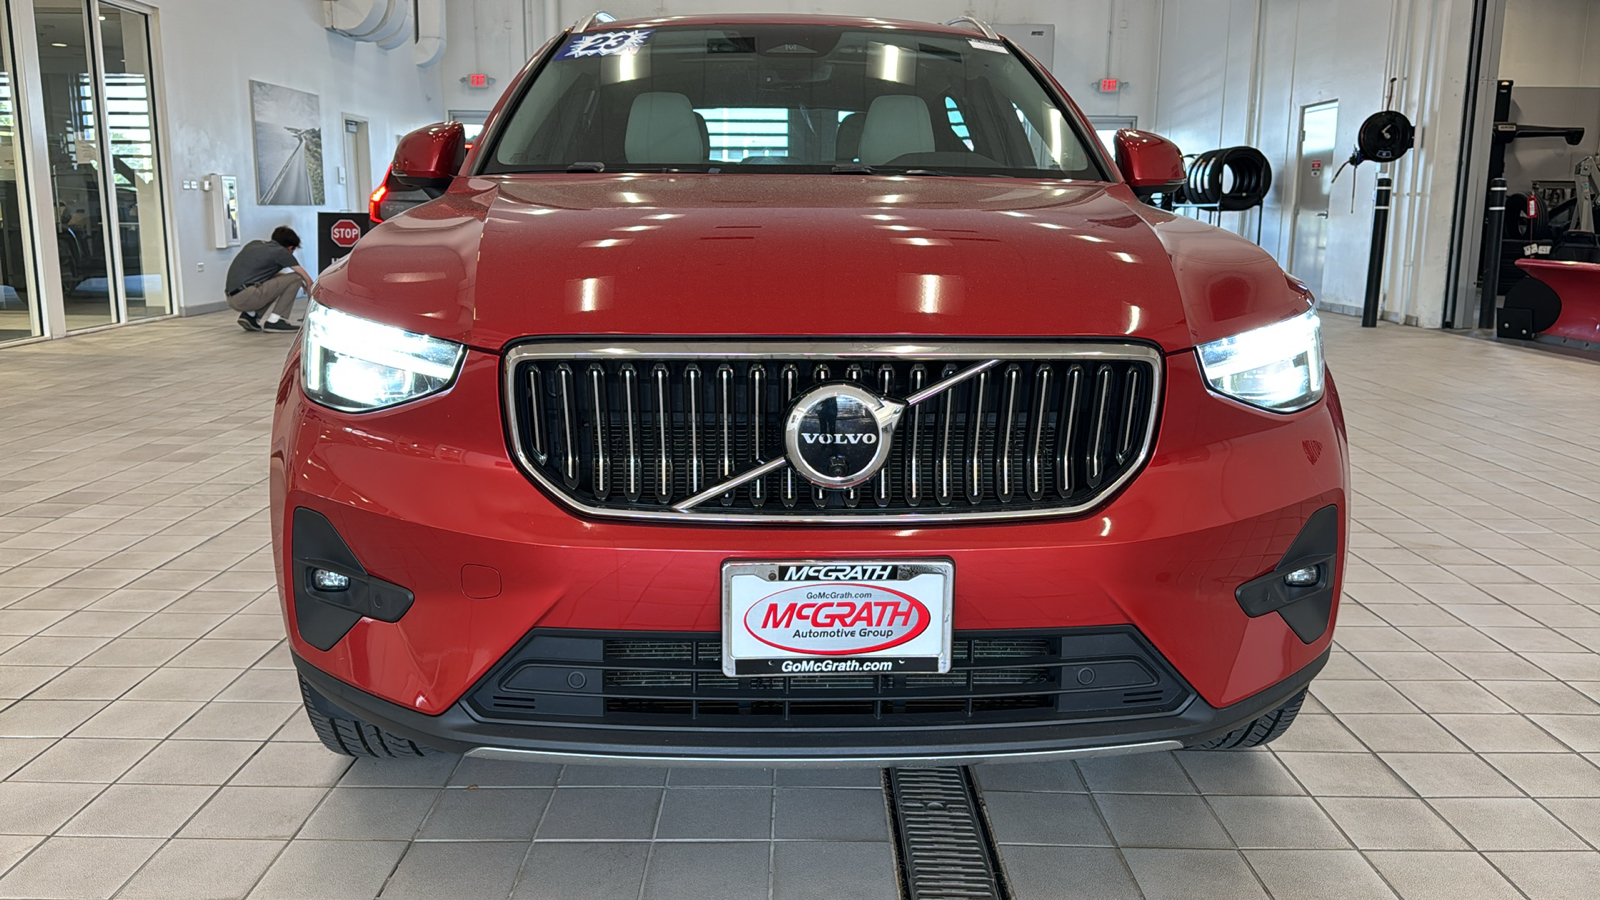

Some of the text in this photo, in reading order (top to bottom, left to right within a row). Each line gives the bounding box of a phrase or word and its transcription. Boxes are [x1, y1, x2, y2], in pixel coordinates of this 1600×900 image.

[580, 35, 631, 51] 23
[333, 228, 359, 238] STOP
[801, 432, 877, 445] VOLVO
[806, 591, 872, 600] GoMcGrath.com
[793, 628, 893, 638] Automotive Group
[781, 660, 893, 672] GoMcGrath.com
